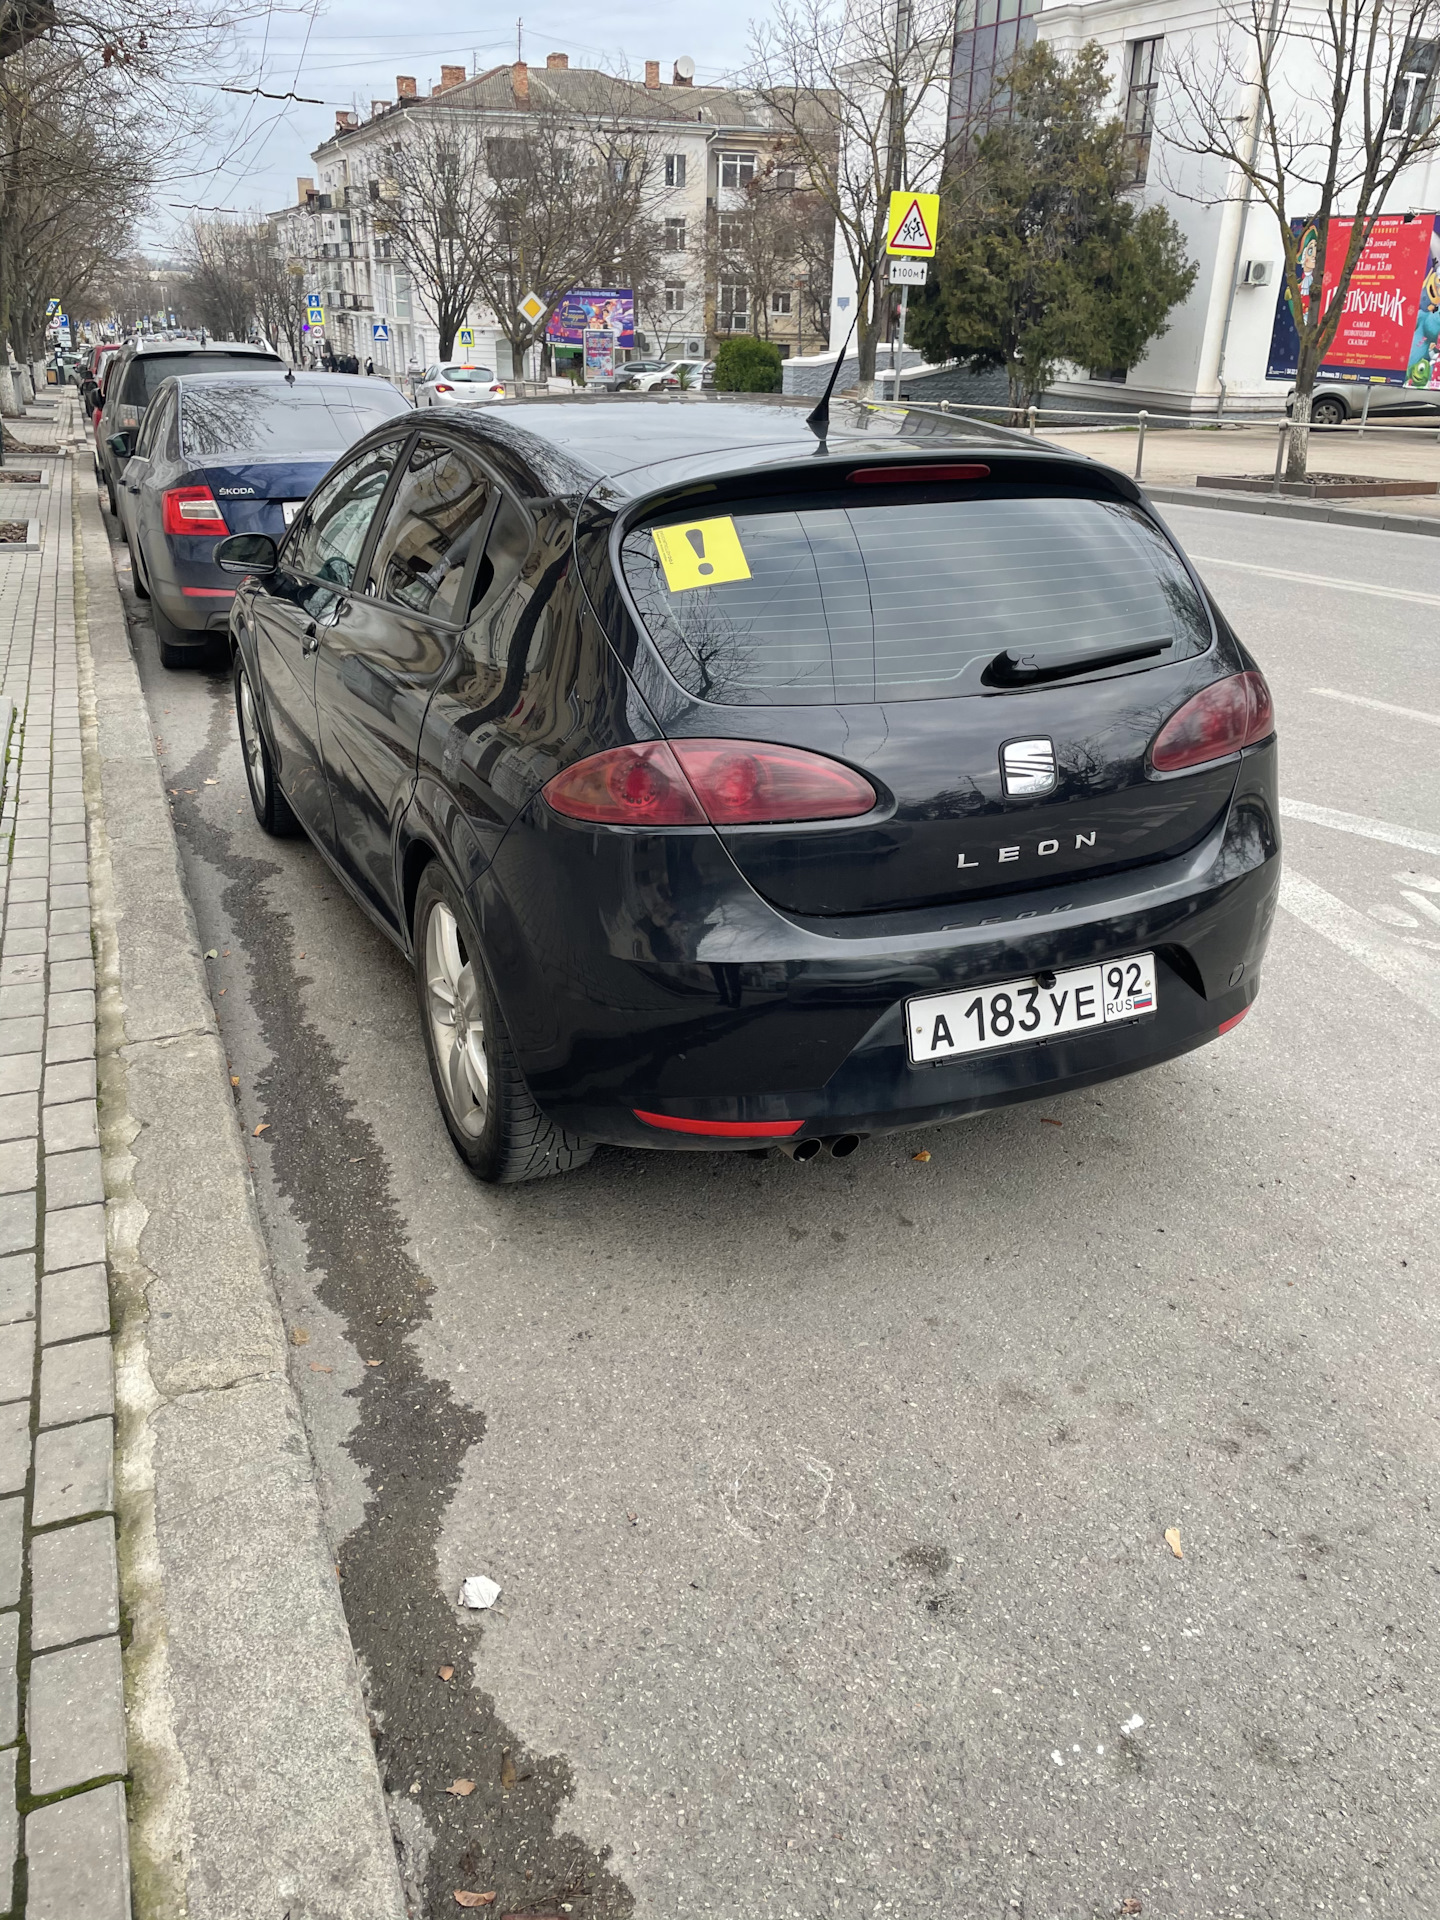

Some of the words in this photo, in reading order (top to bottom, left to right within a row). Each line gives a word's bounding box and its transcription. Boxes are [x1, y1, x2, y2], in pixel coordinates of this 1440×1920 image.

[1374, 239, 1397, 248] декабря
[219, 487, 255, 496] ŠKODA
[957, 831, 1096, 869] LEON
[1107, 963, 1143, 1001] 92
[1106, 999, 1133, 1015] RUS
